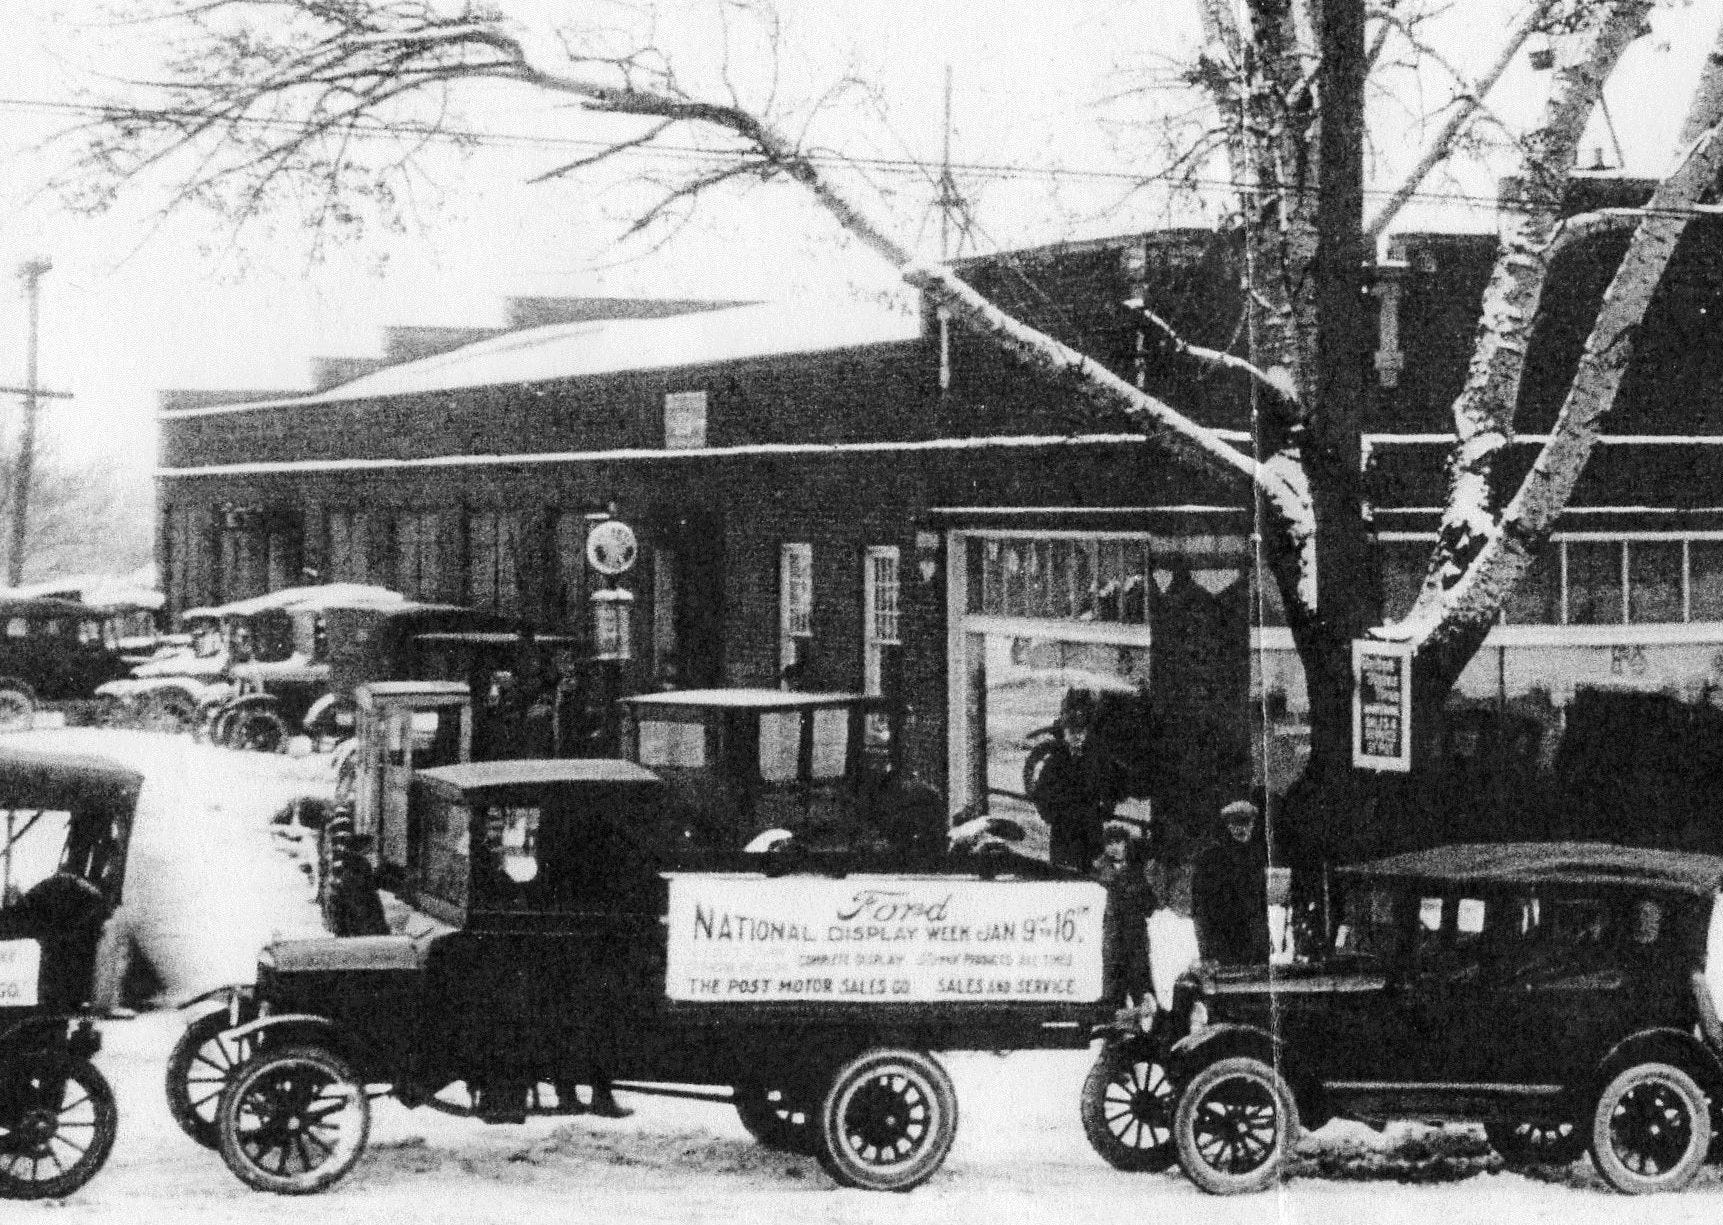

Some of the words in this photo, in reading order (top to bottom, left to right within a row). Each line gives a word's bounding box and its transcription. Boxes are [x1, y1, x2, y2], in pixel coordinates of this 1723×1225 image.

[836, 889, 952, 922] Ford
[693, 903, 817, 942] NATIONAL
[827, 925, 918, 942] DISPLAY
[926, 925, 970, 942] WEEK
[976, 921, 1016, 942] JAN
[689, 977, 721, 995] THE
[726, 977, 773, 995] POST
[777, 977, 833, 995] MOTOR
[838, 978, 887, 995] SALES
[937, 977, 984, 995] SALES
[1015, 977, 1077, 996] SERVICE
